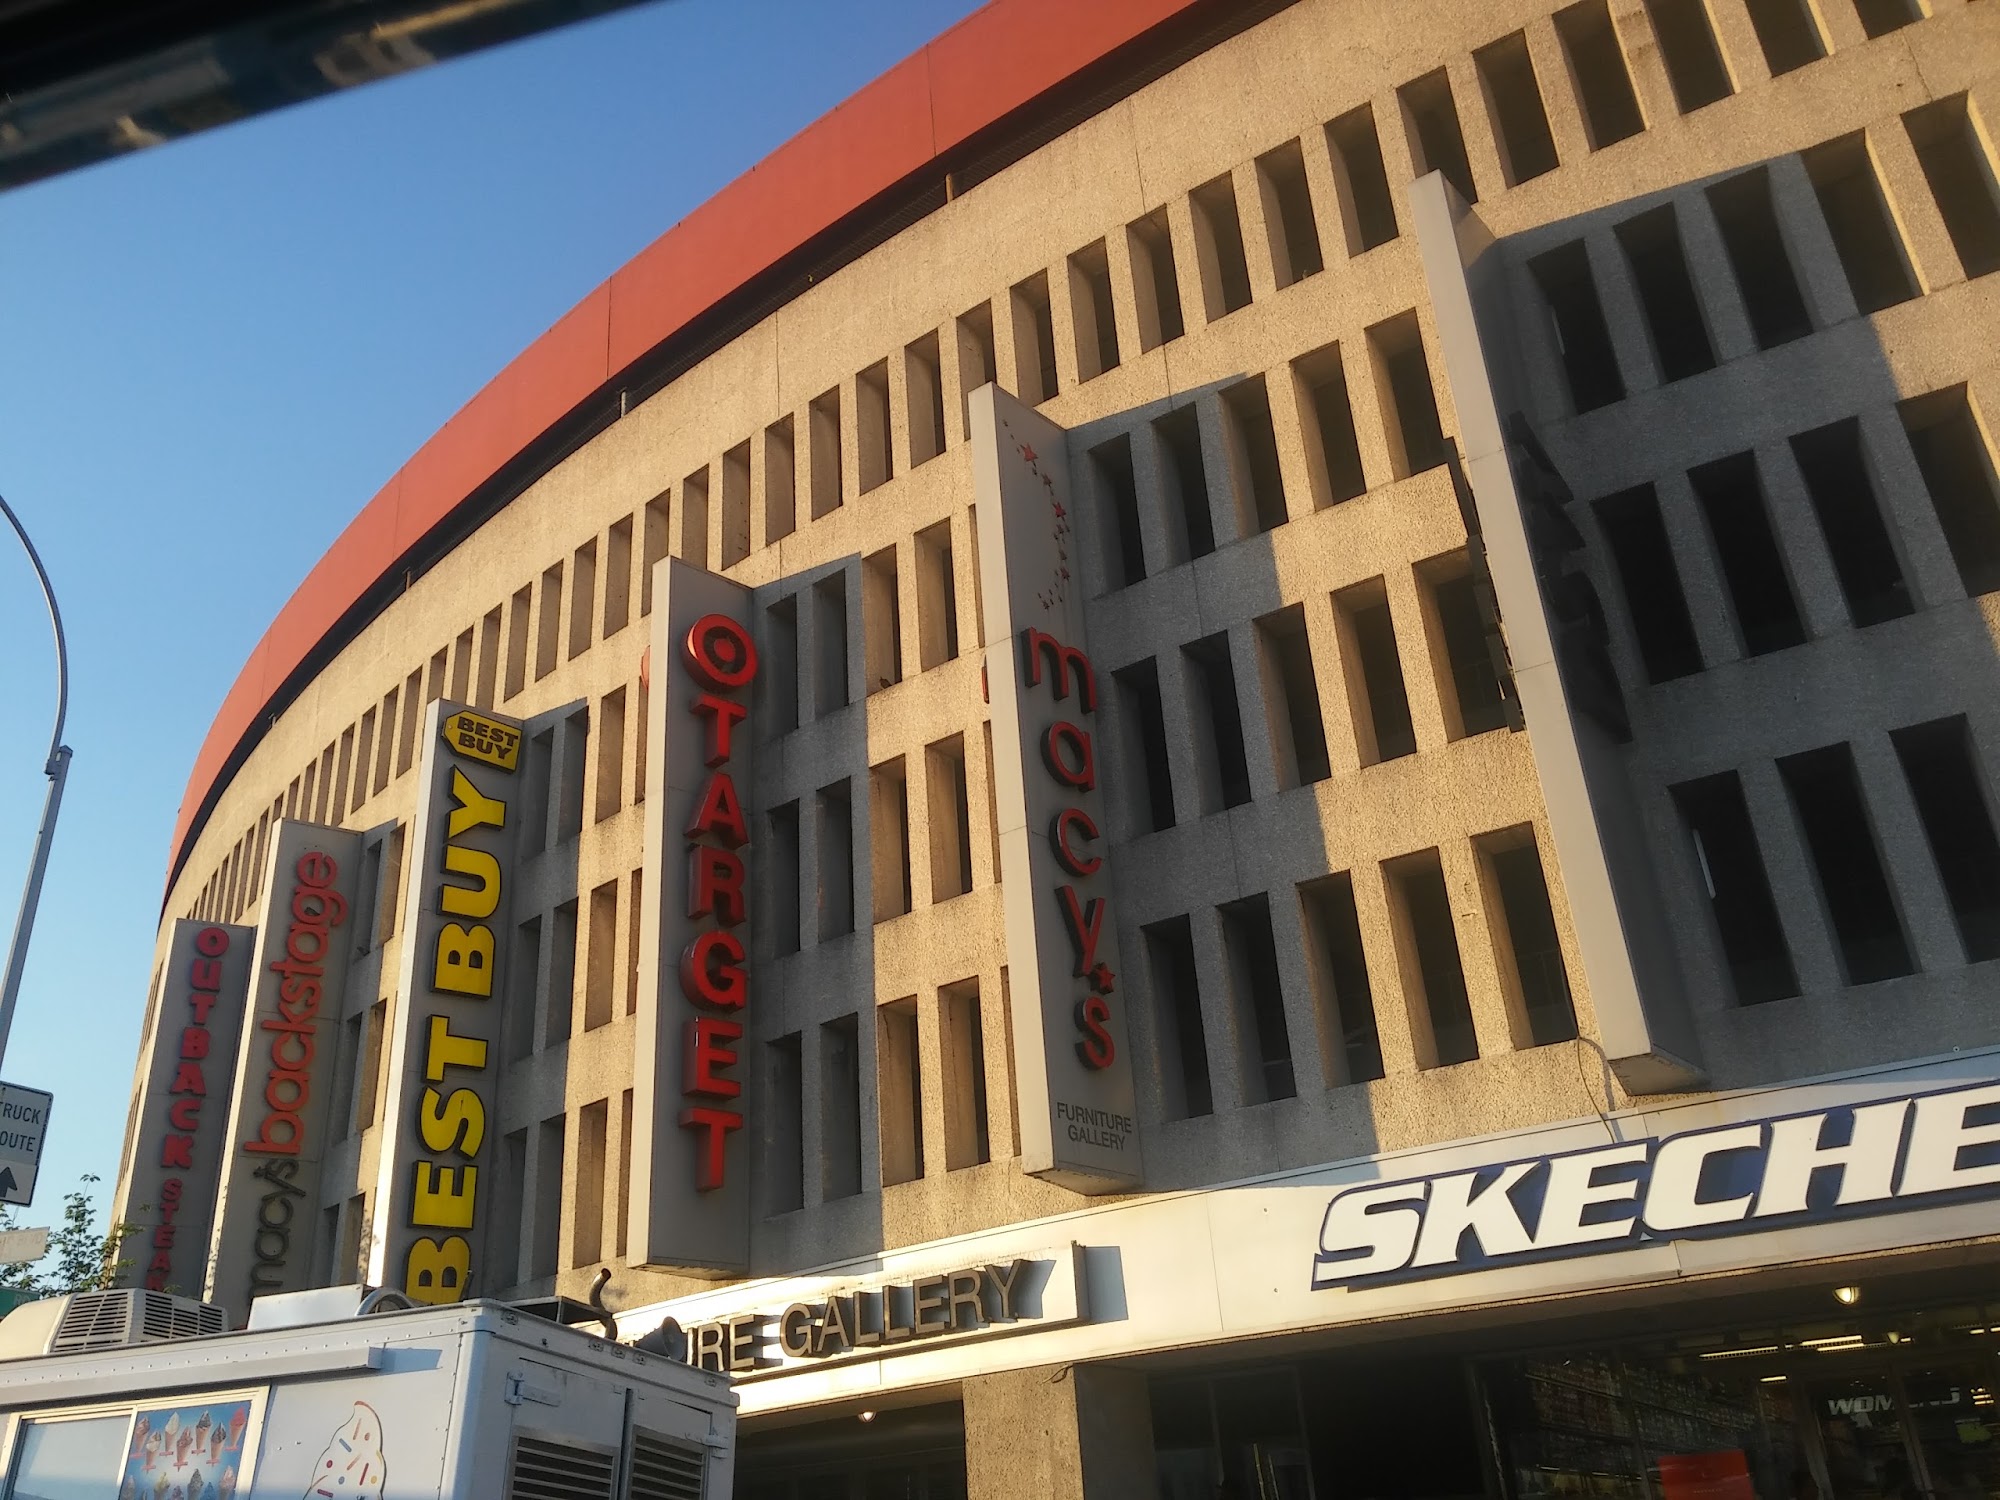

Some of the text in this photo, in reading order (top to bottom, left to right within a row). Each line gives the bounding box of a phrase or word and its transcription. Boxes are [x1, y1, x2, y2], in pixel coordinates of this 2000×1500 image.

[457, 716, 518, 747] BEST
[458, 732, 512, 759] BUY
[679, 694, 749, 1191] TARGET
[161, 927, 229, 1169] OUTBACK
[245, 851, 347, 1154] backstage
[406, 765, 506, 1304] BEST BUY
[1057, 1102, 1132, 1133] FURNITURE
[1068, 1124, 1125, 1151] GALLERY
[780, 1259, 1028, 1358] GALLERY
